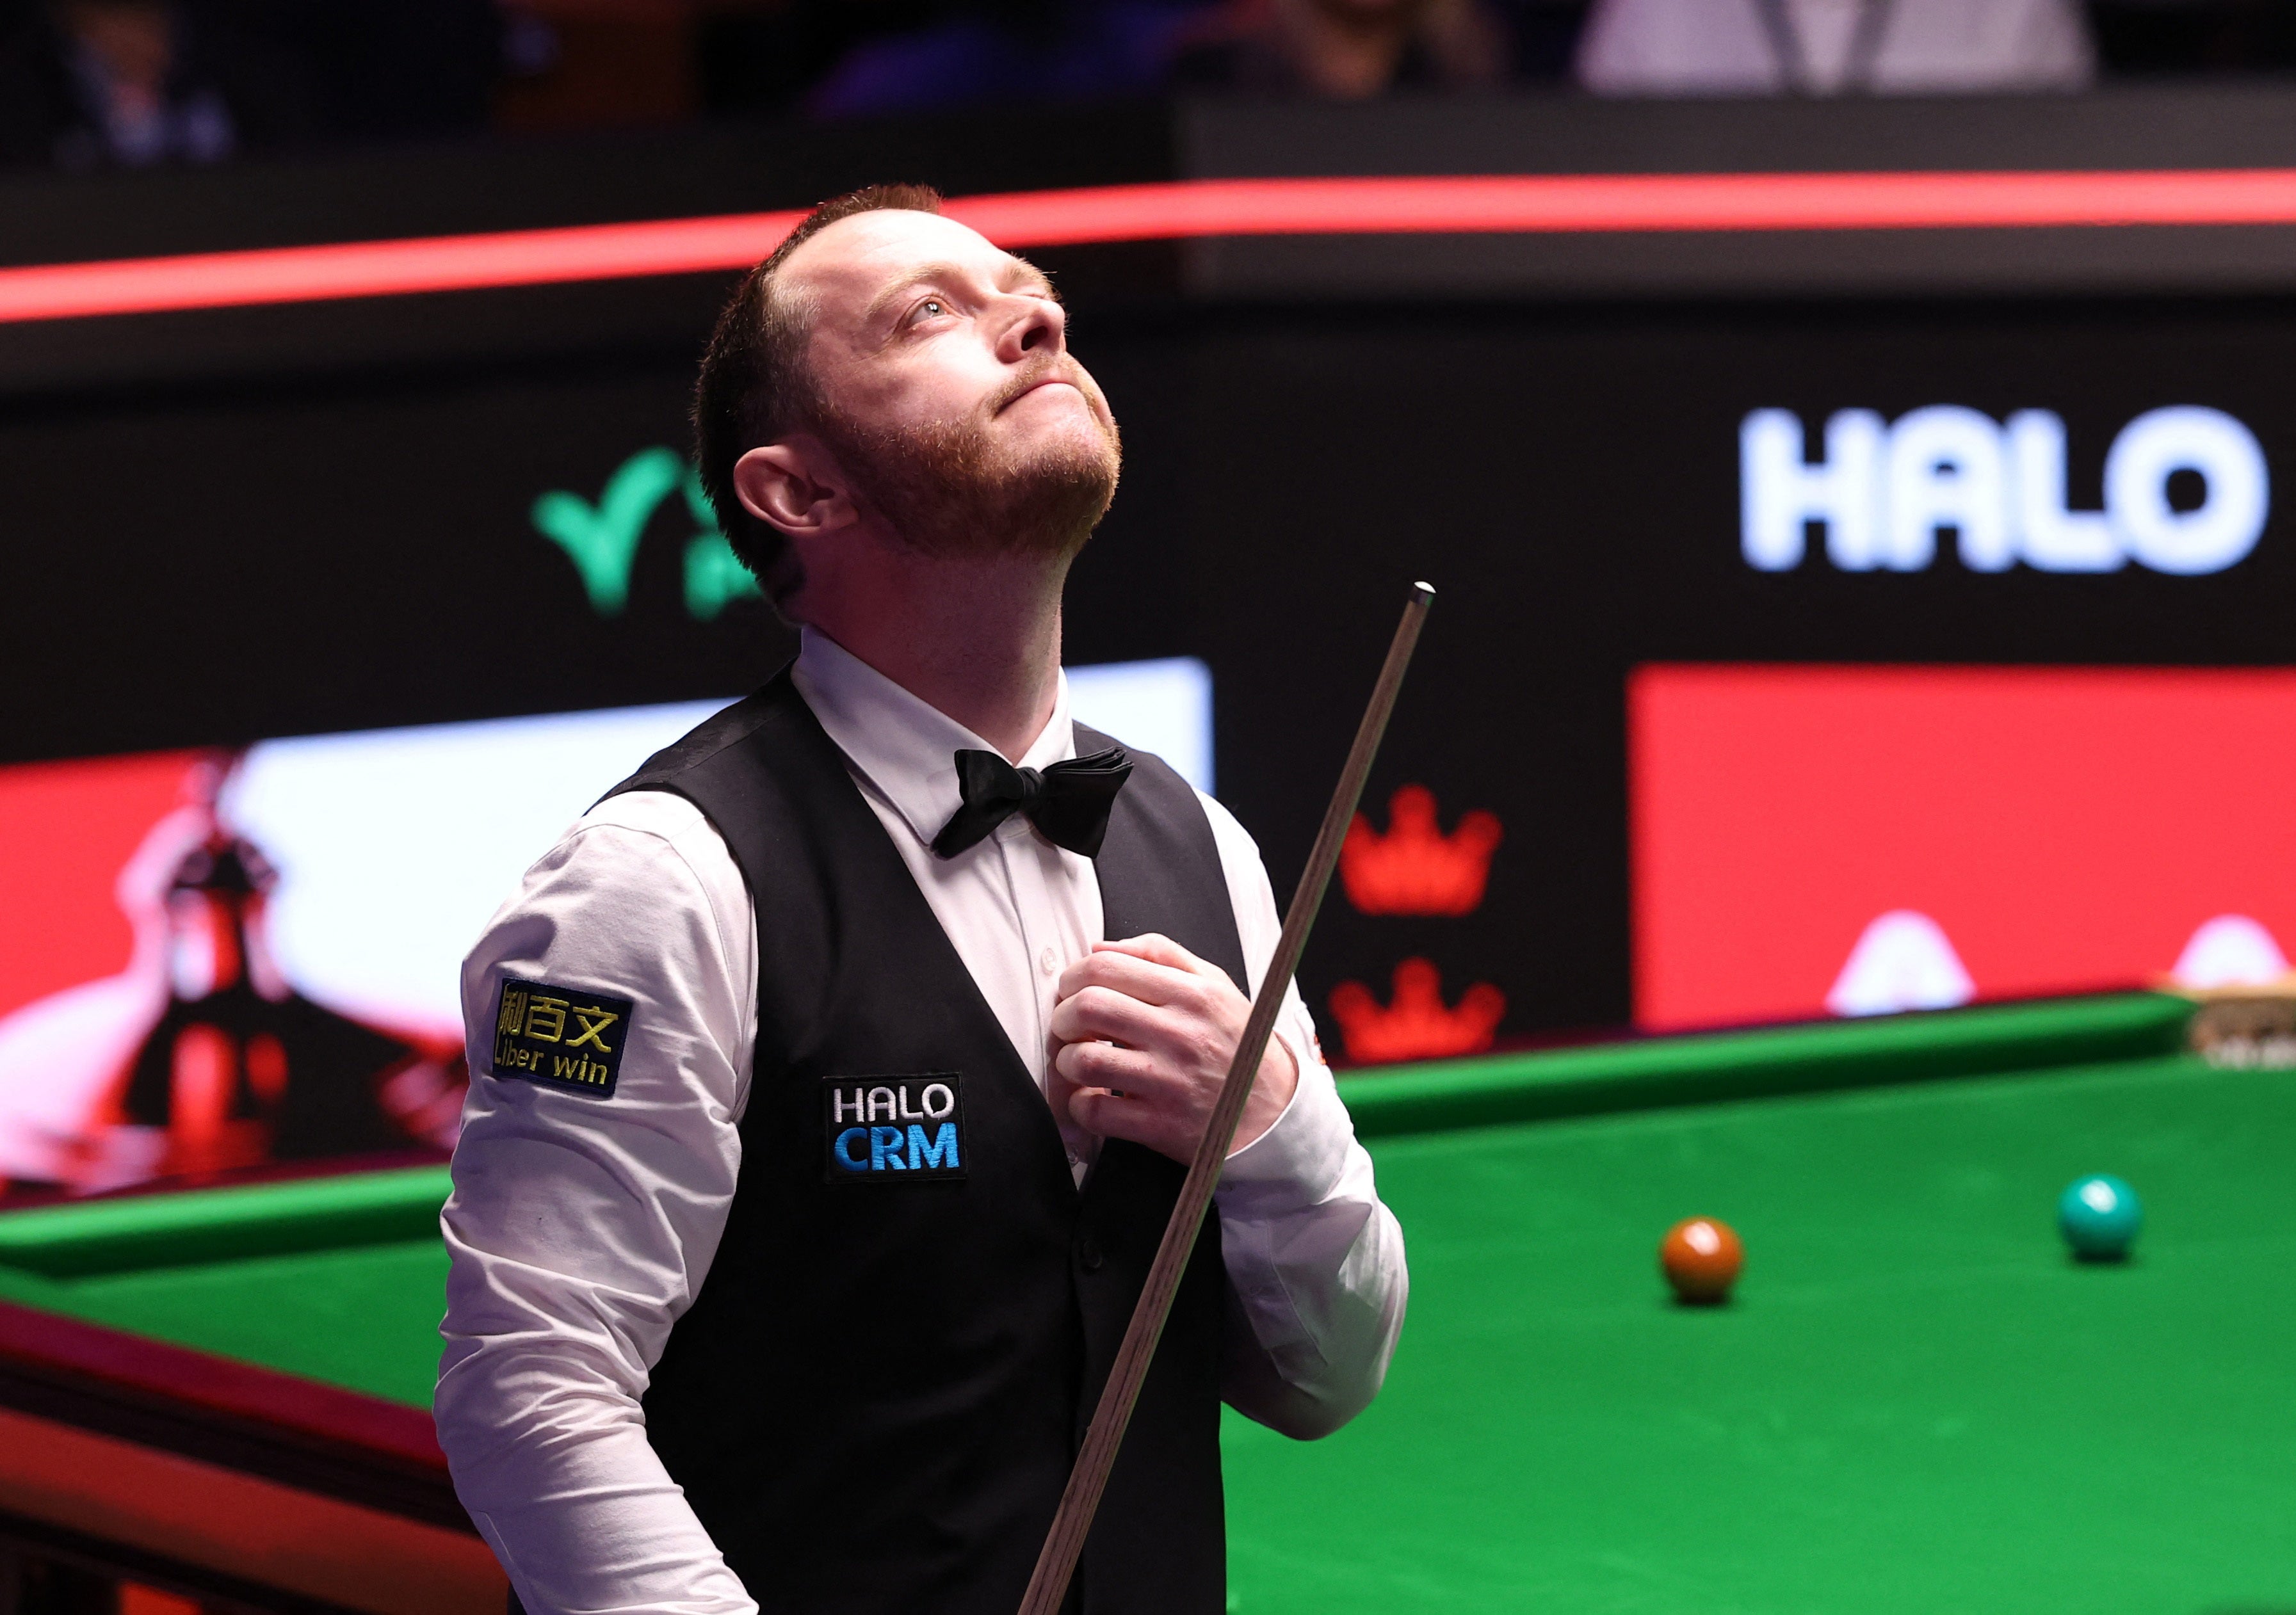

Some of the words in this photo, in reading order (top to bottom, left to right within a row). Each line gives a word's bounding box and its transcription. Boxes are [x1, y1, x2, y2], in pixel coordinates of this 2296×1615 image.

[1740, 405, 2269, 574] HALO
[494, 1031, 544, 1072] Liber
[554, 1052, 608, 1085] win
[834, 1083, 954, 1123] HALO
[834, 1122, 960, 1171] CRM
